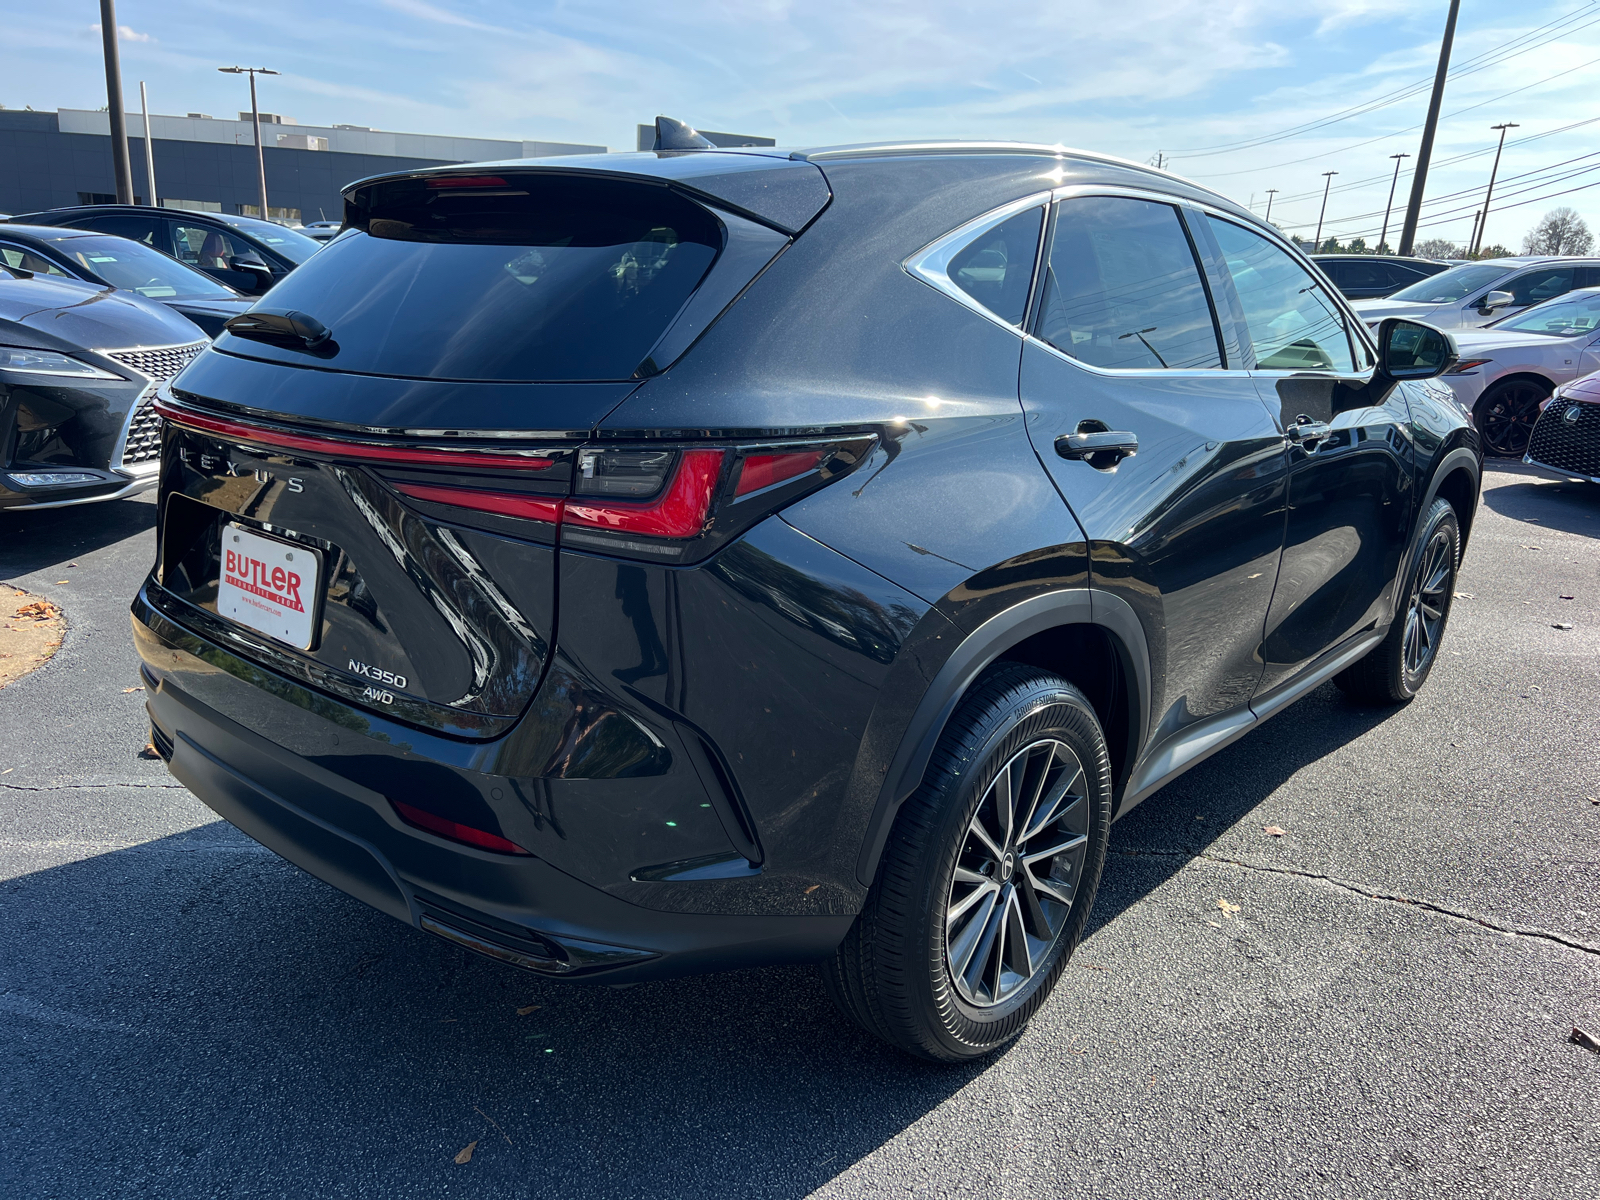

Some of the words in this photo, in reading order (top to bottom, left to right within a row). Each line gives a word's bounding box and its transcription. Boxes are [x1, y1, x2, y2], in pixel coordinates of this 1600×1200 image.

[179, 447, 304, 493] LEXUS
[241, 596, 282, 618] www.butlercars.com
[275, 595, 302, 611] GROUP
[348, 658, 407, 689] NX350
[363, 686, 394, 705] AWD
[1014, 692, 1058, 720] BRIDGESTONE
